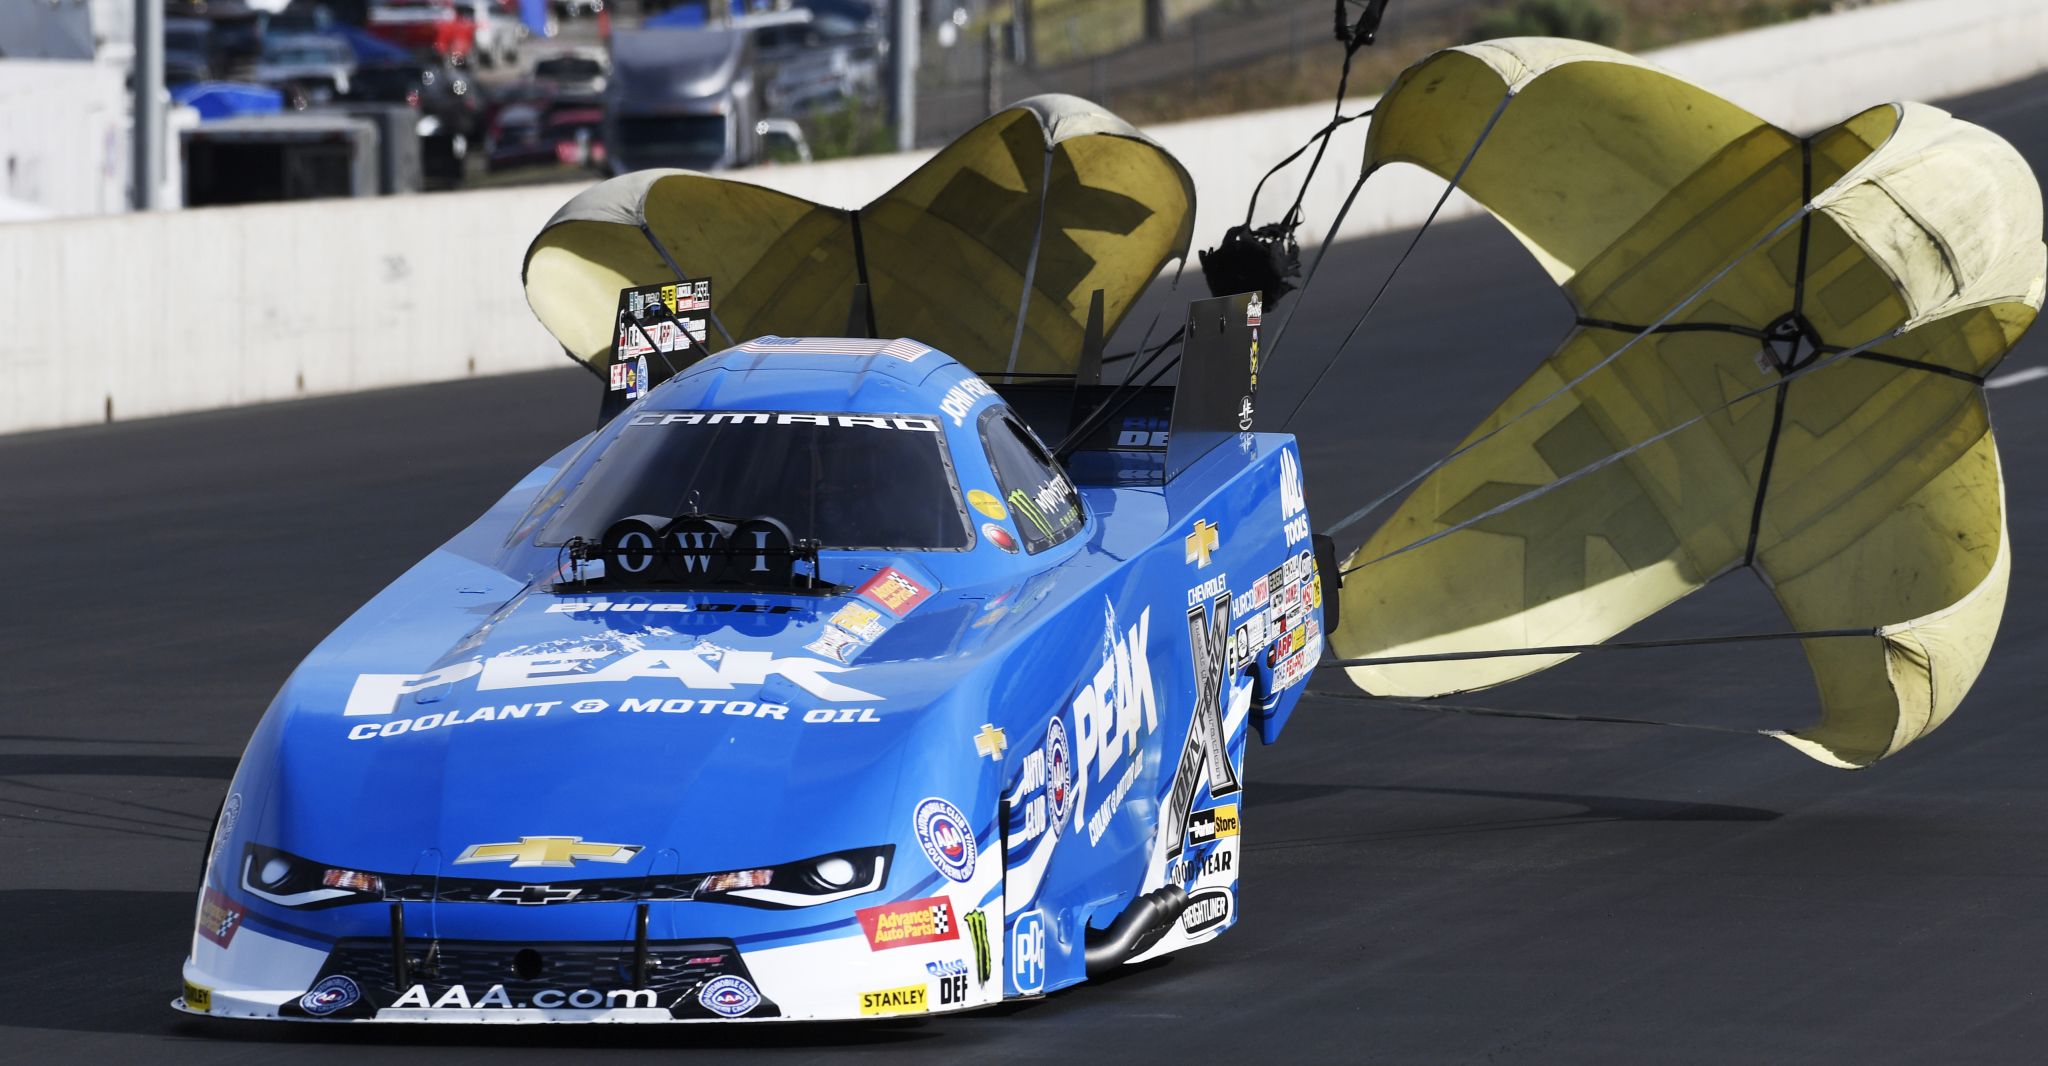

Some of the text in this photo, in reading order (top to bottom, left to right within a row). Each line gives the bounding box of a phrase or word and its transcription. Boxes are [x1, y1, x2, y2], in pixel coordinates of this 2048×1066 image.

[628, 413, 940, 432] CAMARO
[938, 385, 977, 428] JOHN
[1284, 513, 1309, 547] TOOLS
[1188, 573, 1227, 607] CHEVROLET
[1232, 588, 1255, 620] HURCO
[545, 602, 699, 613] Blue
[343, 650, 888, 717] PEAK
[347, 698, 881, 741] COOLANT & MOTOR OIL
[1073, 604, 1158, 834] PEAK
[1022, 748, 1045, 796] AUTO
[918, 801, 967, 836] AUTOMOBILE CLUB
[1025, 795, 1046, 841] CLUB
[1215, 816, 1237, 833] Store
[934, 826, 963, 850] AAA
[924, 843, 962, 881] SOUTHERN
[879, 909, 931, 929] Advance
[1182, 896, 1227, 929] FREIGHTLINER
[875, 924, 934, 944] Auto Parts
[926, 958, 969, 978] Blue
[391, 983, 657, 1010] AAA.com
[717, 993, 744, 1003] AAA
[863, 988, 926, 1008] STANLEY
[940, 974, 969, 1005] DEF
